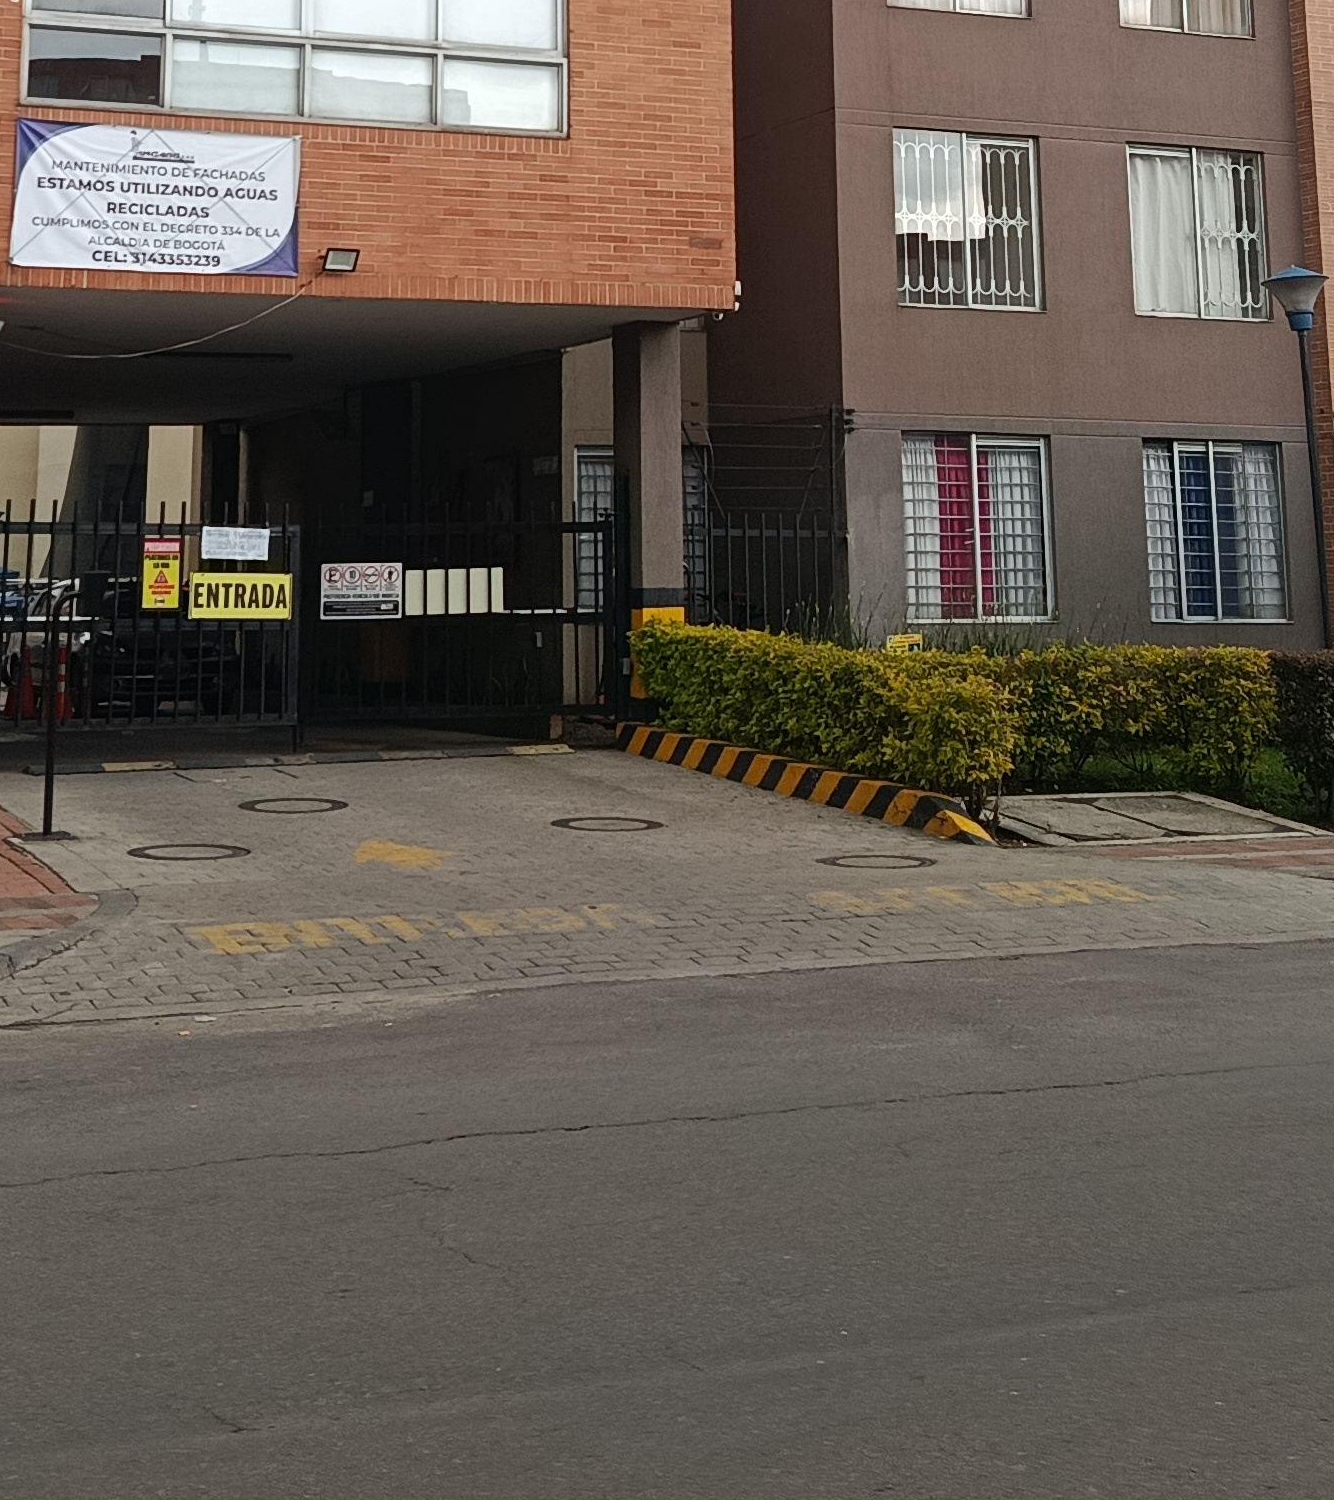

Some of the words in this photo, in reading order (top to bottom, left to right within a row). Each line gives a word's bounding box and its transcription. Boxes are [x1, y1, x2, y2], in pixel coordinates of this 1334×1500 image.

[51, 160, 168, 177] MANTENIMIENTO
[171, 167, 190, 178] DE
[193, 169, 266, 182] FACHADAS
[37, 176, 115, 193] ESTAMOS
[120, 182, 218, 198] UTILIZANDO
[223, 187, 279, 201] AGUAS
[107, 202, 210, 218] RECICLADAS
[32, 216, 110, 230] CUMPLIMOS
[112, 220, 140, 231] CON
[143, 222, 158, 232] EL
[161, 223, 218, 235] DECRETO
[221, 226, 242, 236] 334
[245, 226, 263, 237] DE
[265, 227, 281, 238] LA
[153, 239, 171, 249] DE
[92, 250, 128, 263] CEL:
[132, 253, 221, 267] 3143353239
[193, 582, 288, 609] ENTRADA
